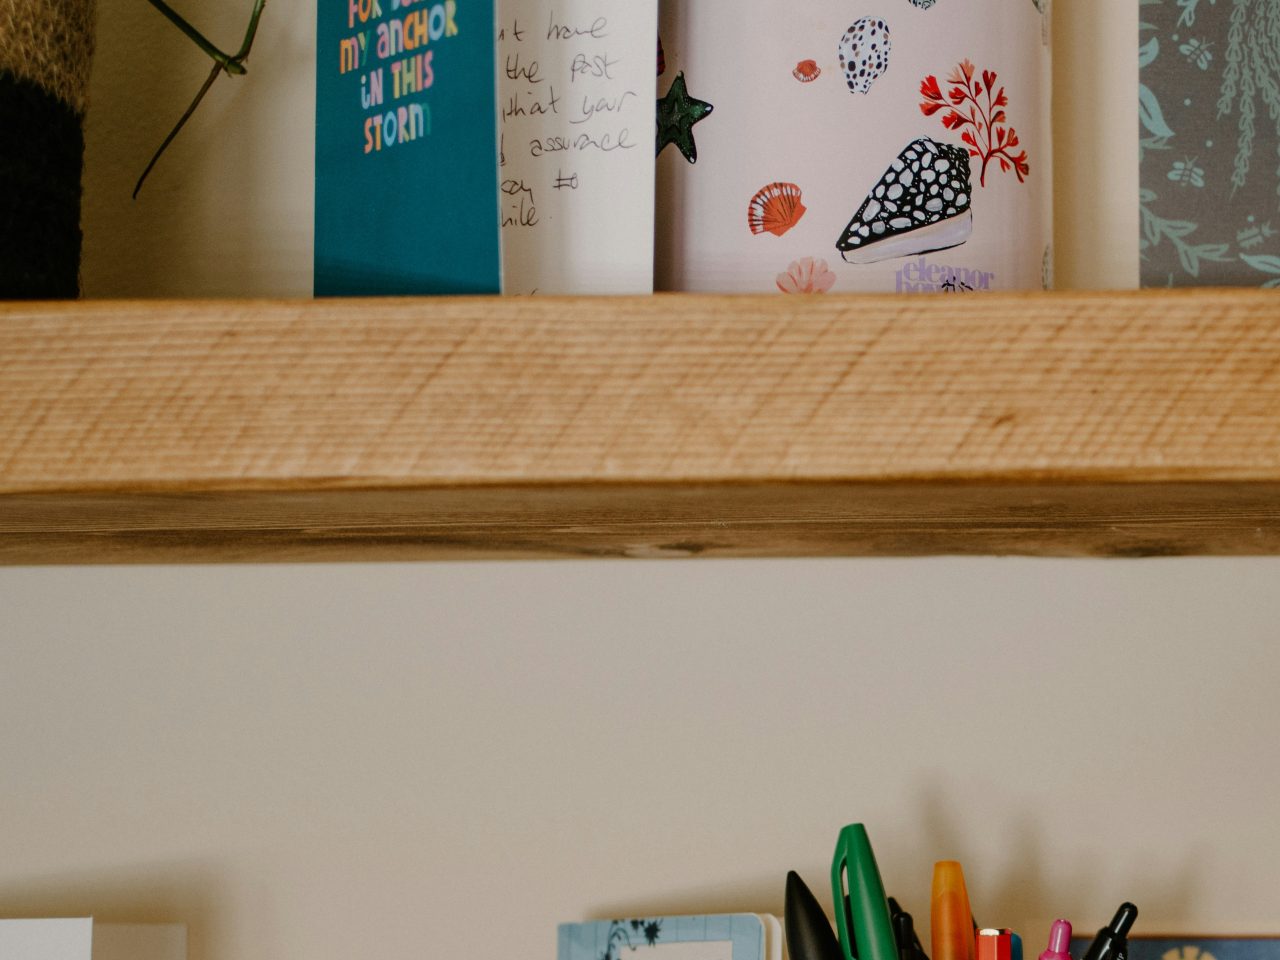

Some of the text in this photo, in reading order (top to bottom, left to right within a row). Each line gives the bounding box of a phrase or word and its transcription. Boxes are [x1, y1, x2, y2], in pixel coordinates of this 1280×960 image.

[391, 50, 434, 99] THIS
[506, 53, 544, 83] the
[903, 257, 995, 290] eleanor
